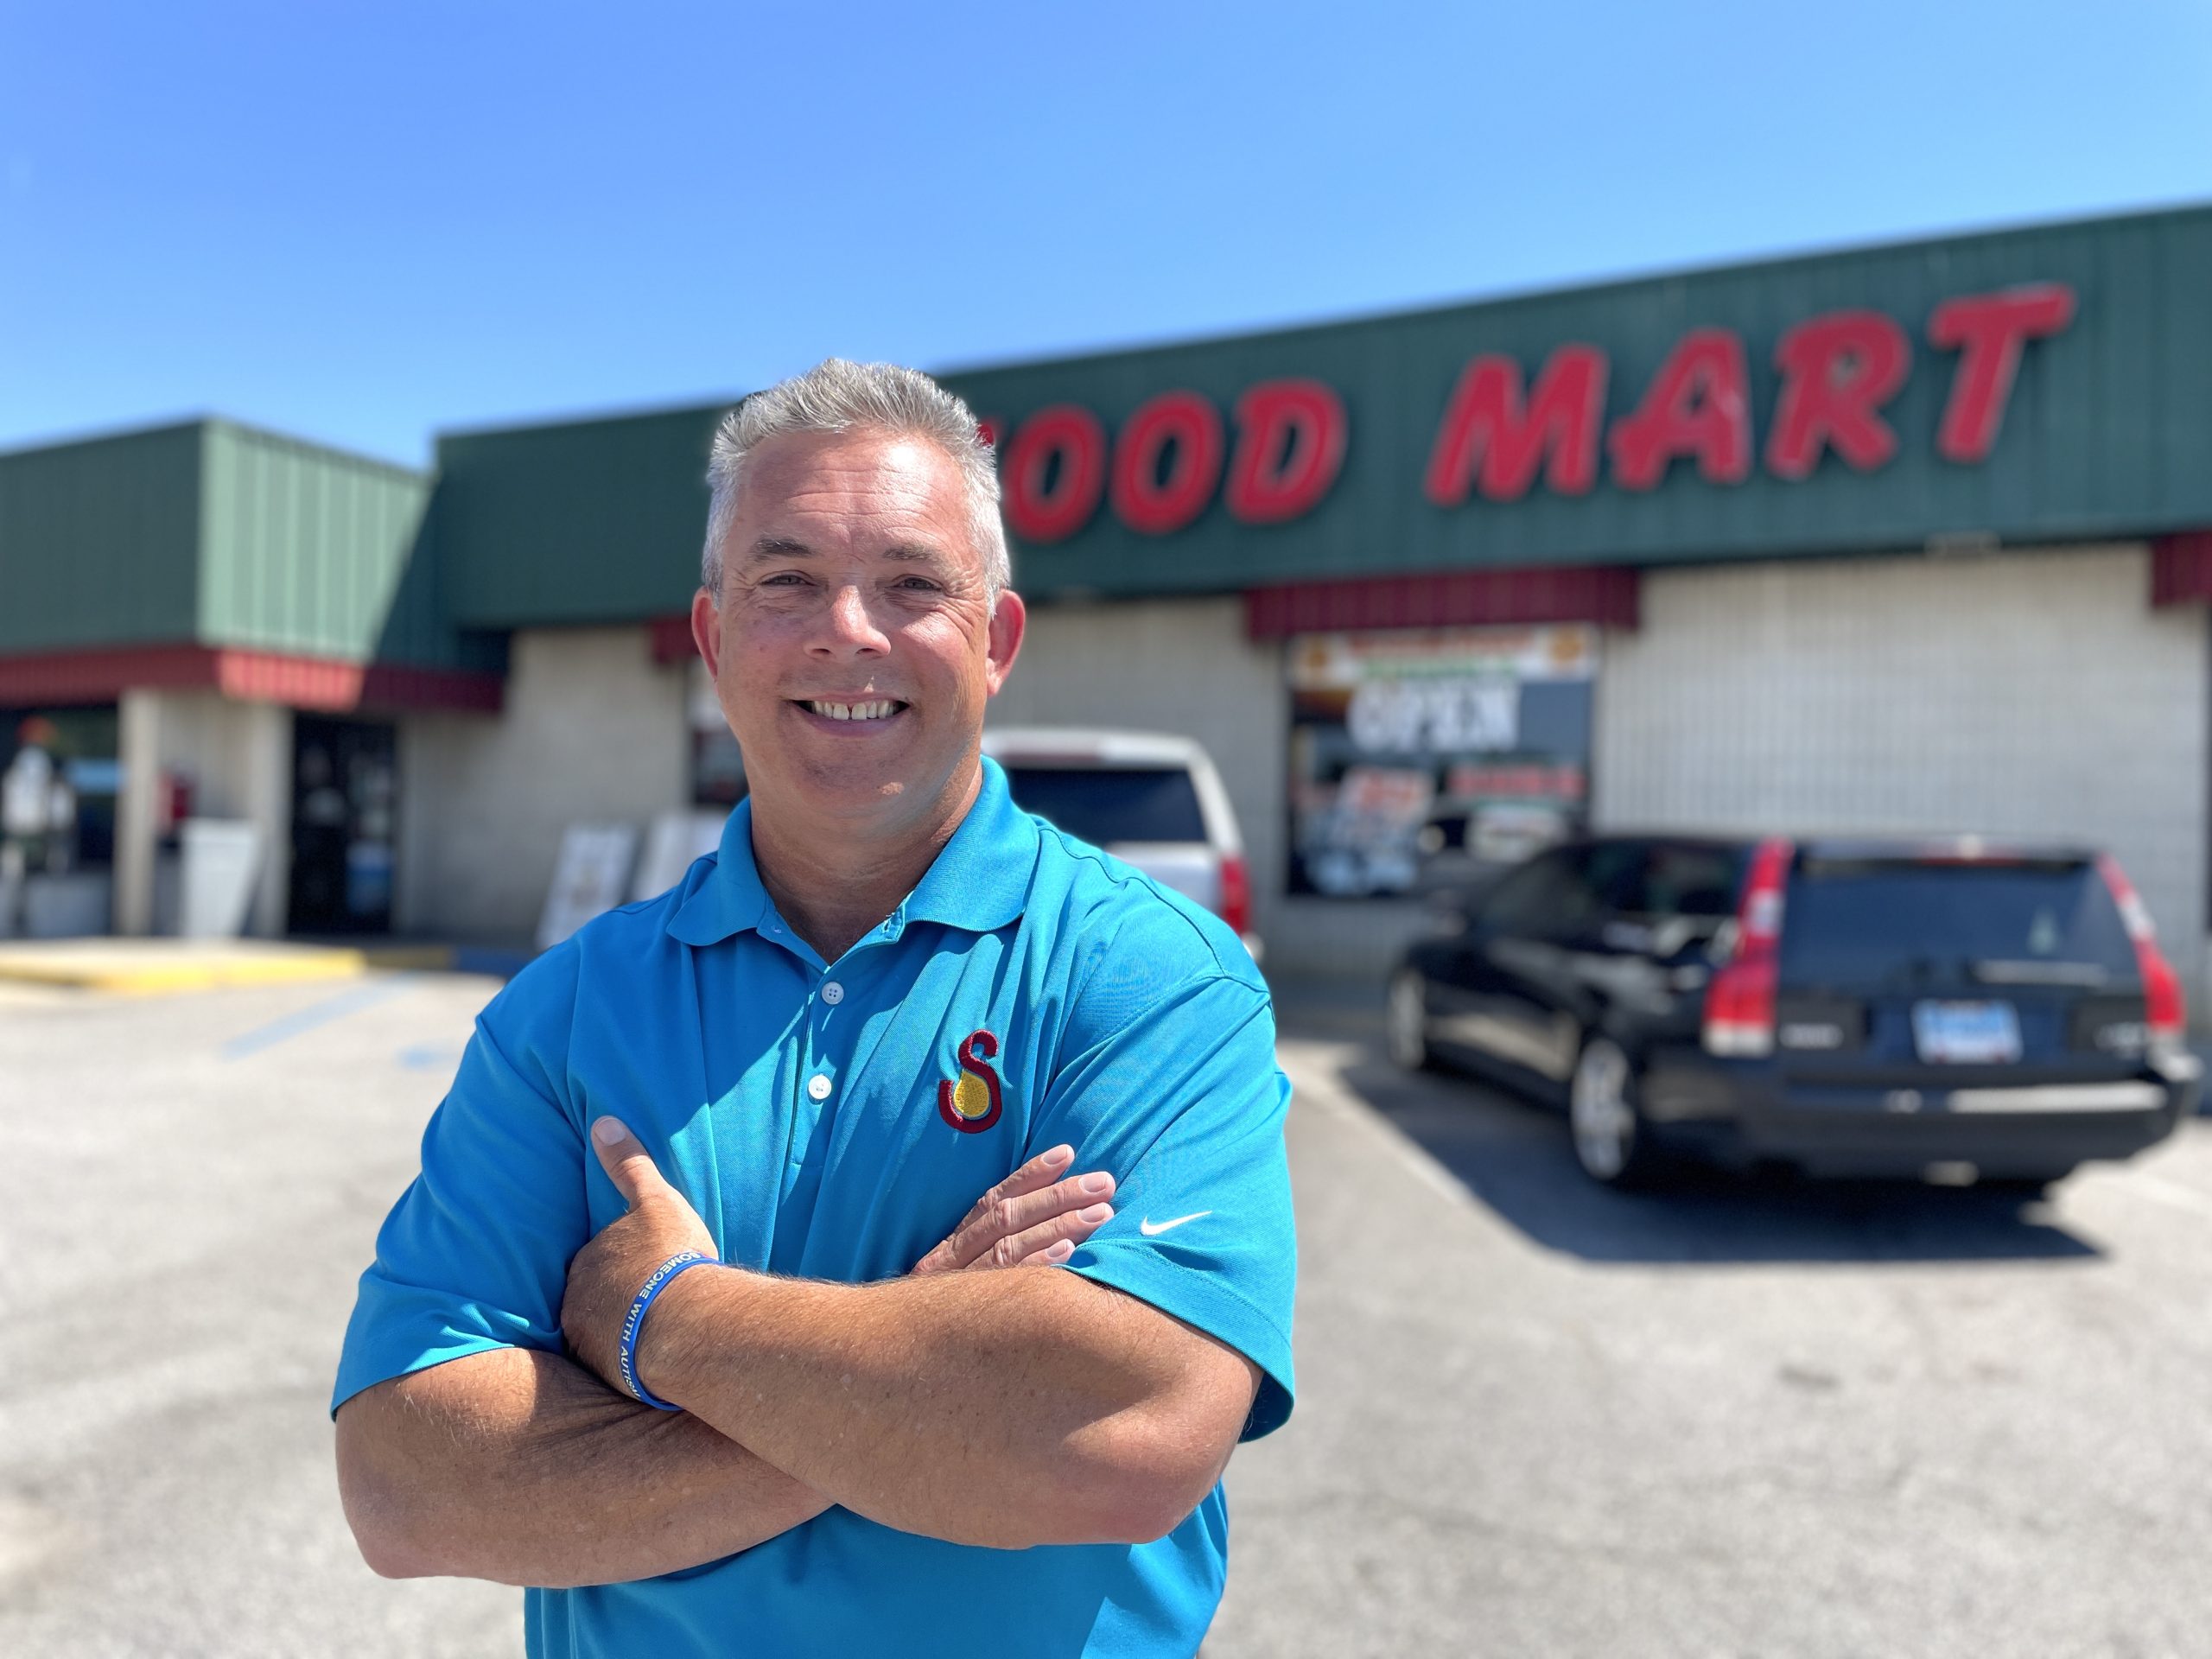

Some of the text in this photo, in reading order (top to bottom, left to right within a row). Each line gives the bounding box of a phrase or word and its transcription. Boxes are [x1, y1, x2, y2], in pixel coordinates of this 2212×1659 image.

[977, 283, 2075, 544] OOD MART
[1347, 678, 1521, 753] OPEN
[938, 1028, 1002, 1134] S
[639, 1252, 701, 1300] SOMEONE
[622, 1303, 642, 1342] WITH
